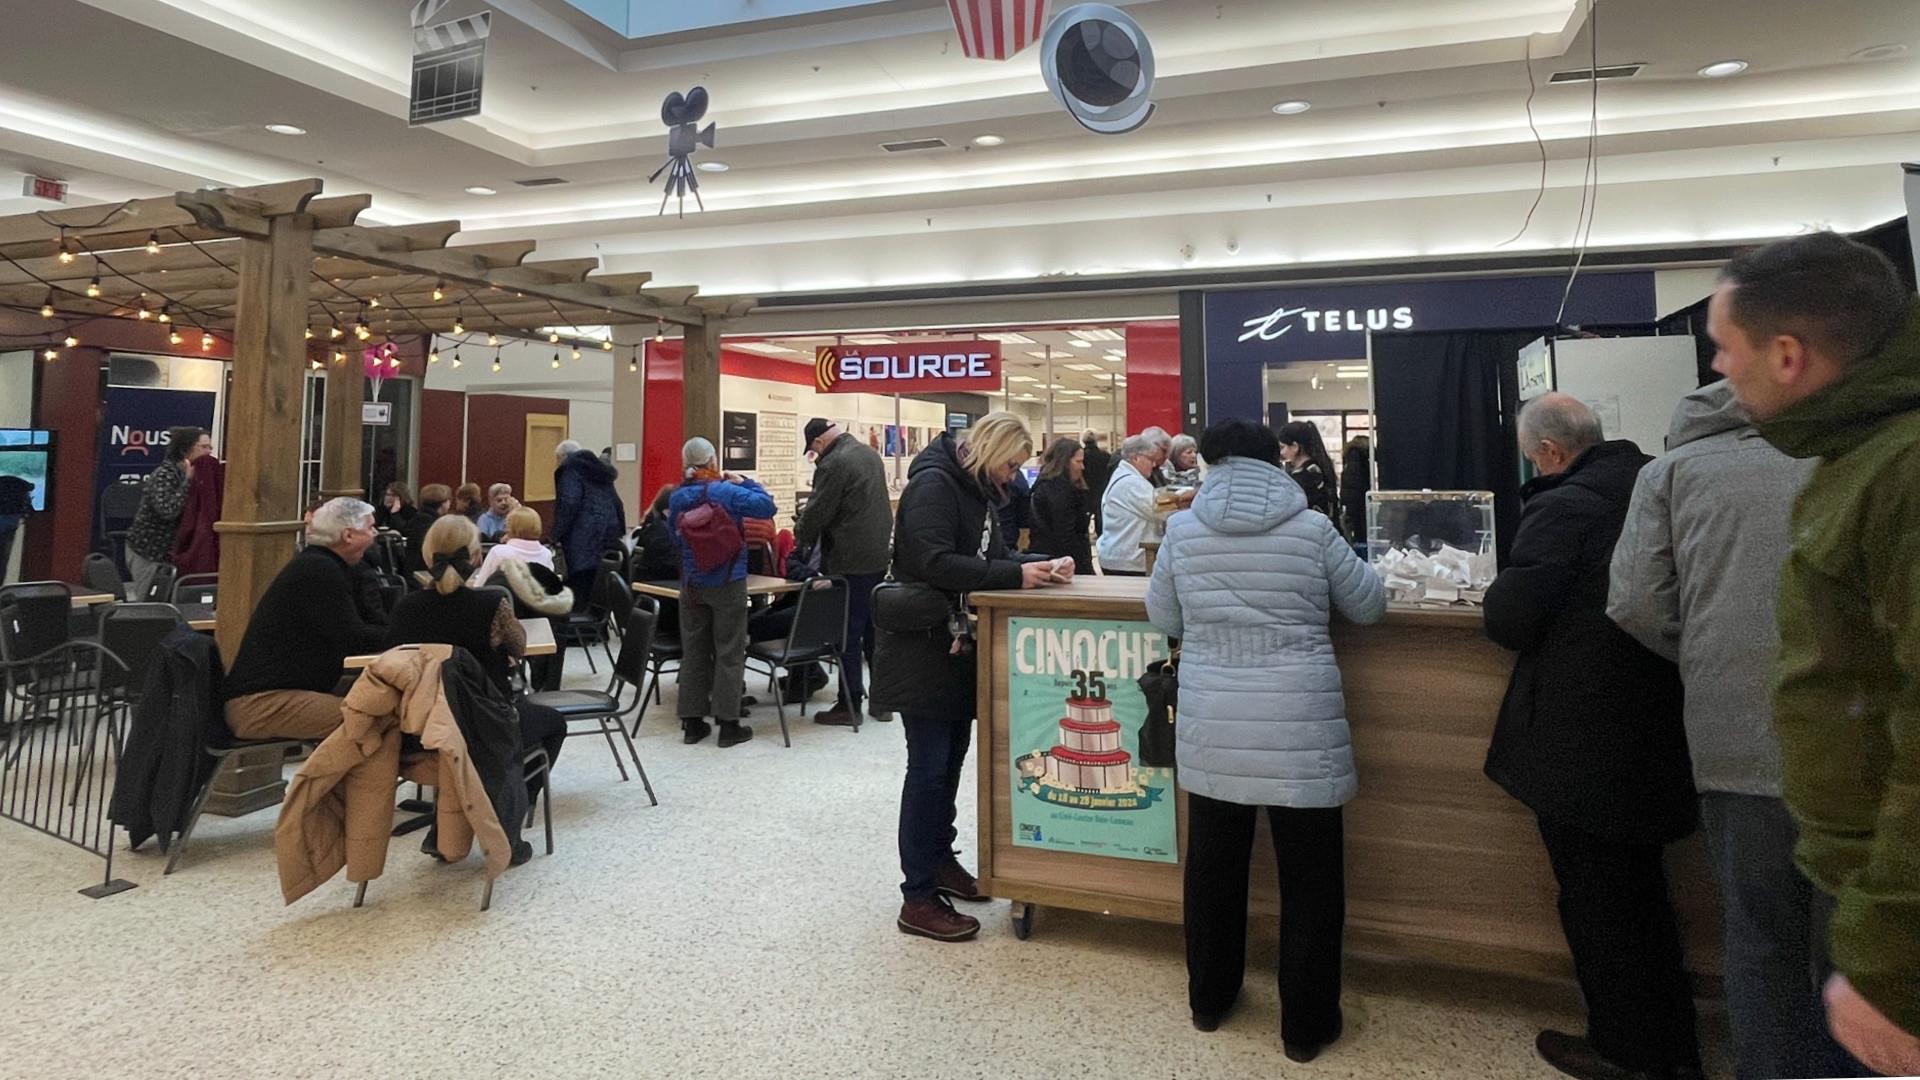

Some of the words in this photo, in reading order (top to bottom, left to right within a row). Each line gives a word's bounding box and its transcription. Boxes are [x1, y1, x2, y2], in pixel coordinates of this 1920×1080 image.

[1301, 307, 1413, 332] TELUS
[839, 353, 992, 380] SOURCE
[111, 425, 172, 446] Nous
[1070, 669, 1106, 700] 35
